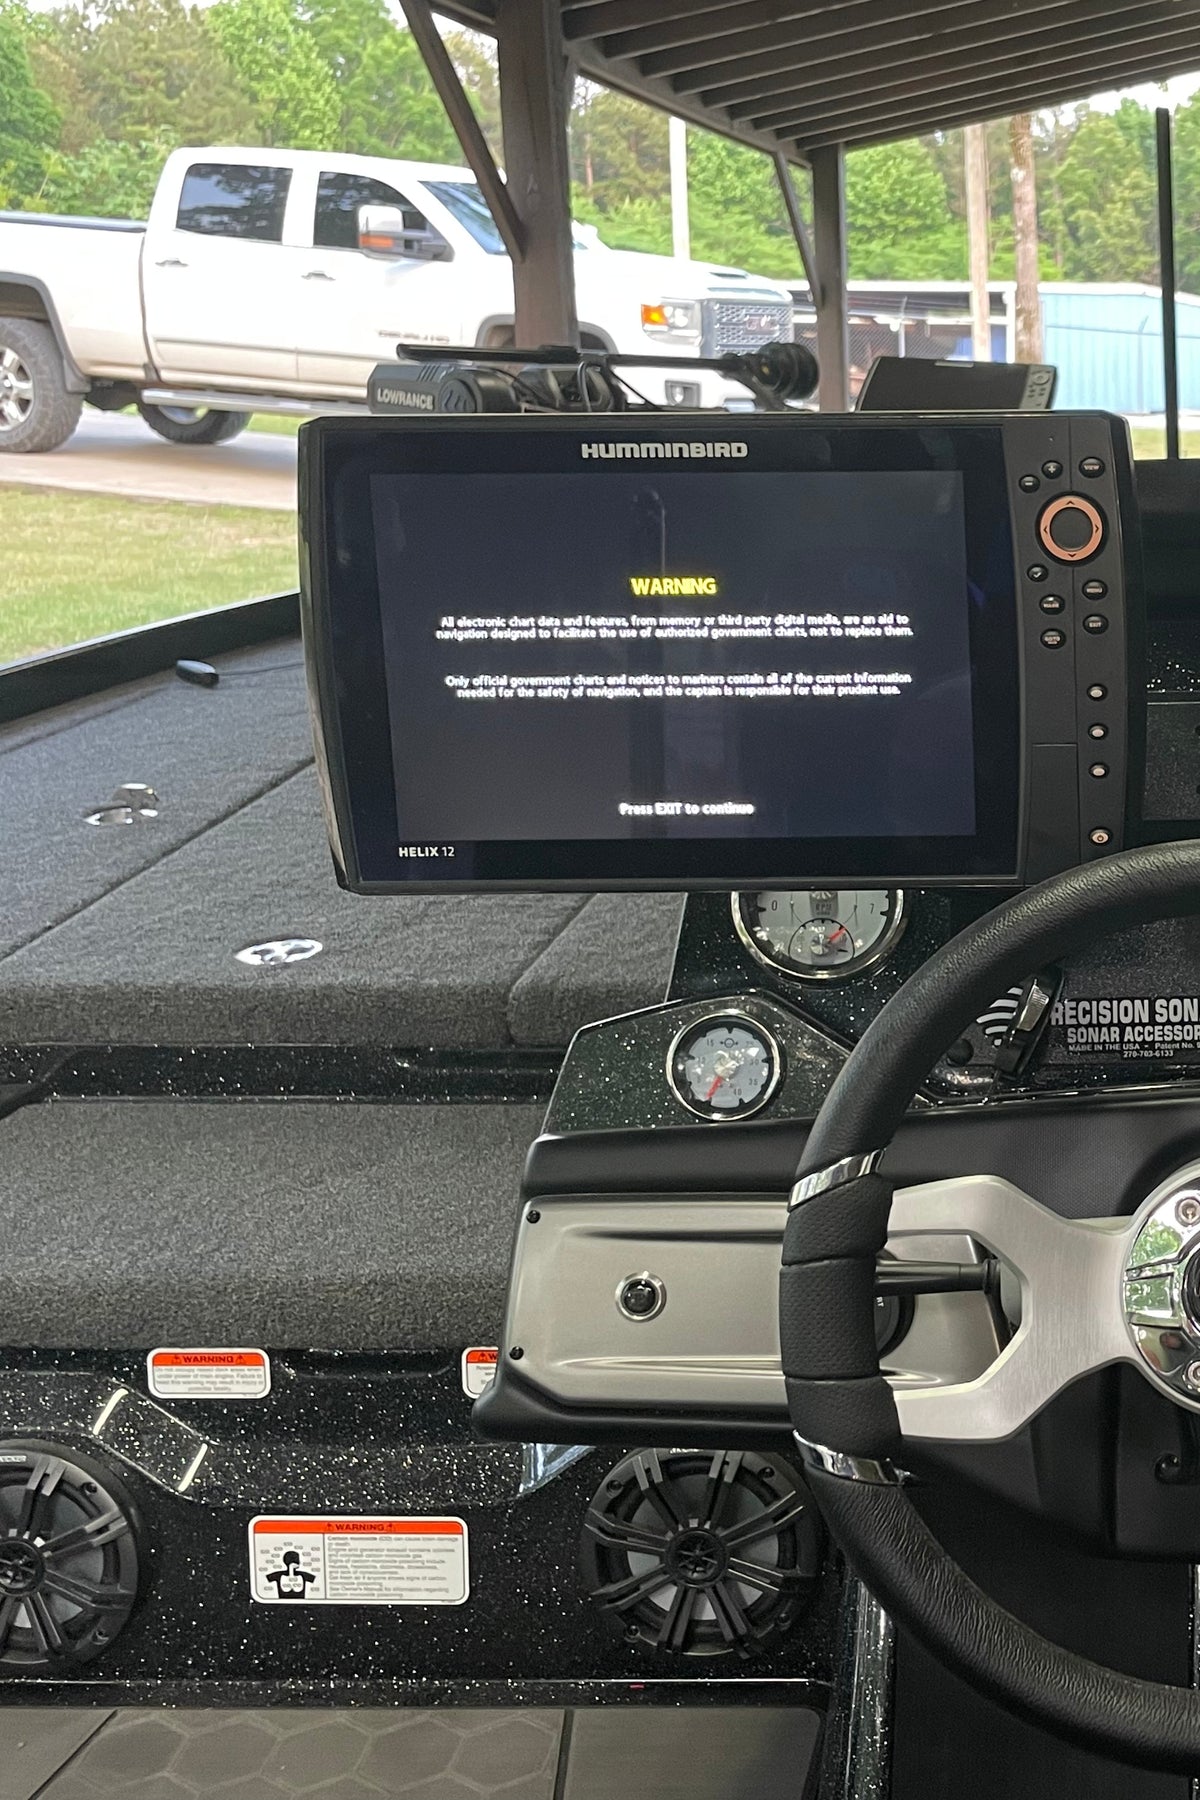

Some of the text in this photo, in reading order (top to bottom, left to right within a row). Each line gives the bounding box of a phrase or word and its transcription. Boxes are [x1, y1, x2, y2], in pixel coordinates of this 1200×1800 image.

[377, 388, 434, 410] LOWRANCE
[581, 443, 748, 458] HUMMINBIRD
[630, 577, 717, 595] WARNING
[441, 614, 908, 629] All electronic chart data and features, from memory or third party digital media, are an aid to
[619, 802, 754, 815] Press EXIT to continue
[399, 846, 455, 858] HELIX 12
[771, 899, 778, 911] 0
[869, 903, 875, 915] 7
[1050, 999, 1149, 1025] RECISION
[1067, 1026, 1120, 1043] SONAR
[706, 1039, 715, 1047] 15
[1105, 1043, 1121, 1051] THE
[183, 1355, 234, 1363] WARNING
[336, 1523, 384, 1531] WARNING
